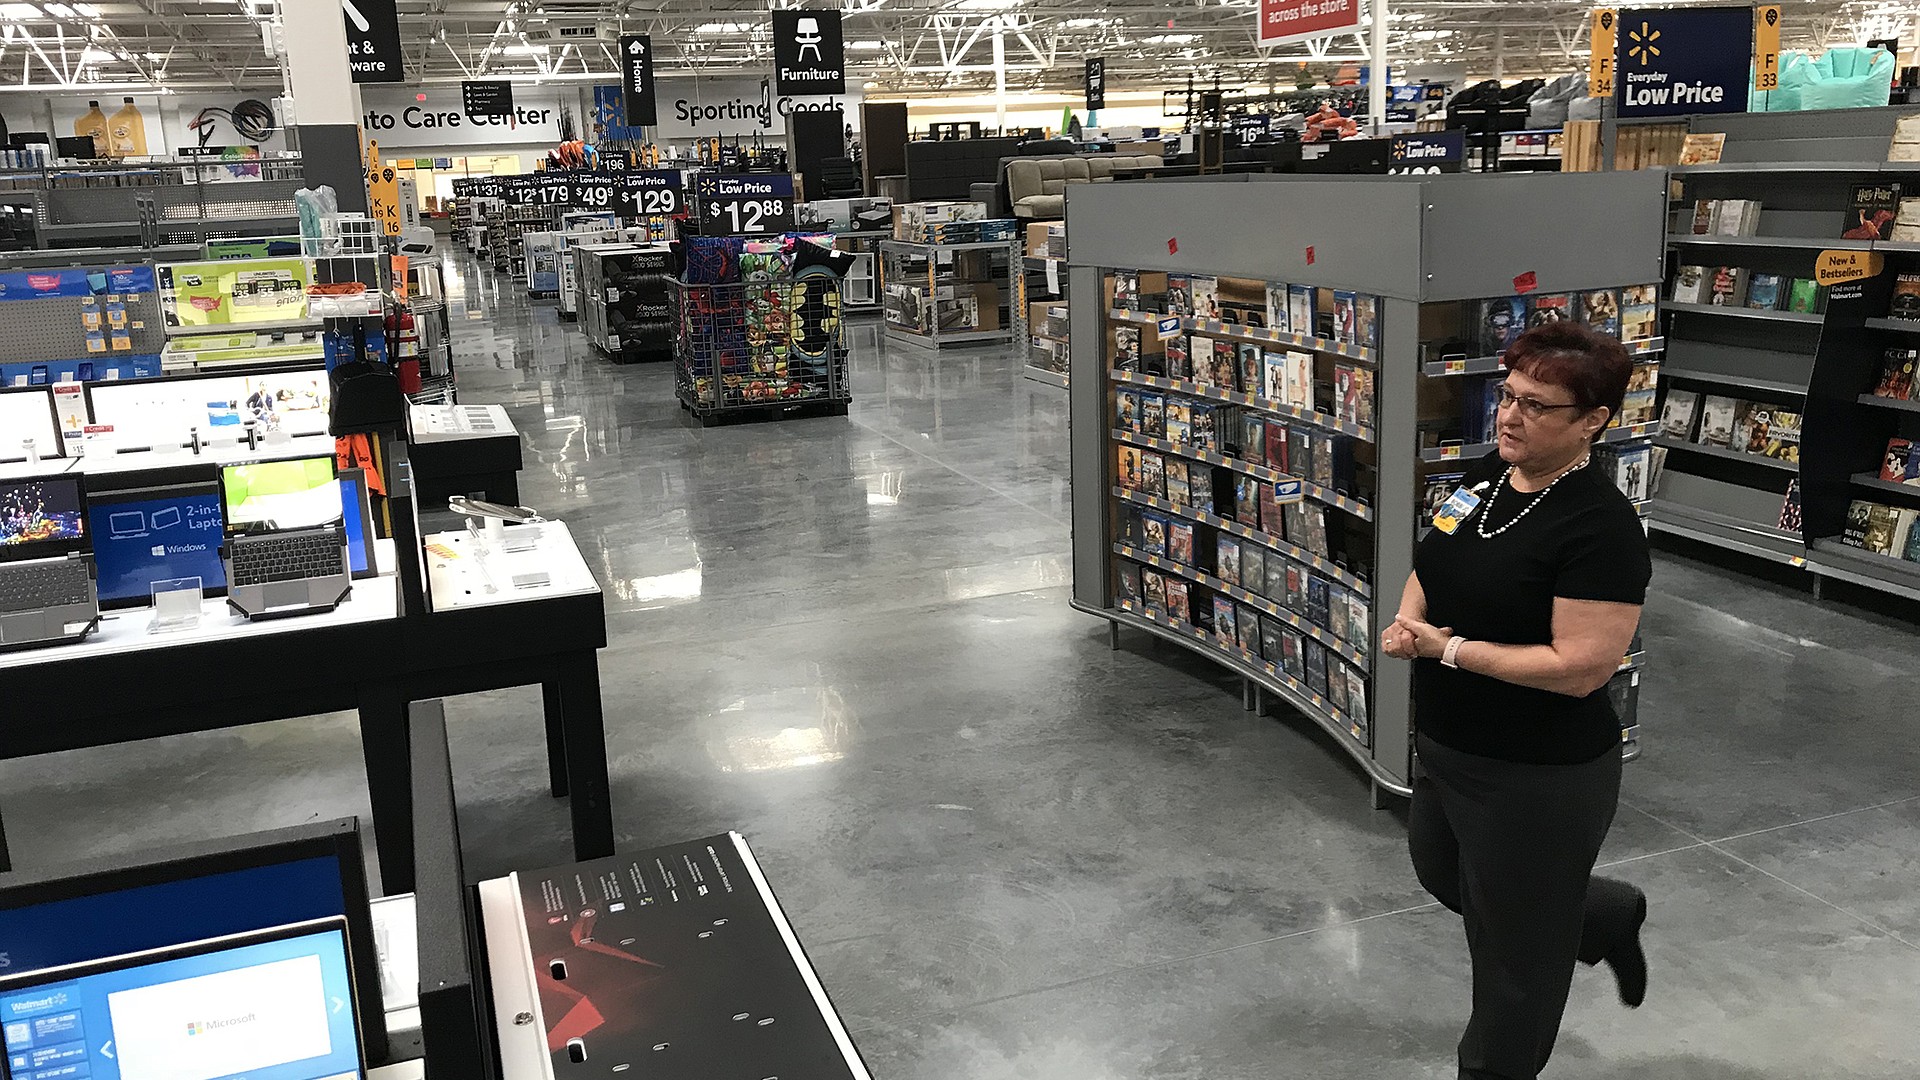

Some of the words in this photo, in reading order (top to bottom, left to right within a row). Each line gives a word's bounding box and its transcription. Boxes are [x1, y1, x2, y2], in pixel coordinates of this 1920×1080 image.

[1268, 7, 1300, 23] across
[1301, 1, 1318, 18] the
[1320, 0, 1350, 15] store.
[363, 40, 375, 54] &
[350, 61, 386, 72] ware
[1600, 58, 1609, 75] F
[1766, 54, 1775, 69] F
[632, 59, 643, 94] Home
[781, 67, 840, 82] Furniture
[1627, 71, 1669, 84] Everyday
[1762, 73, 1777, 87] 33
[1597, 79, 1611, 94] 34
[1625, 84, 1670, 107] Low
[1672, 80, 1724, 104] Price
[403, 106, 461, 129] Care
[1406, 146, 1424, 158] Low
[1424, 143, 1447, 157] Price
[594, 176, 612, 184] Price
[627, 178, 645, 187] Low
[645, 177, 666, 186] Price
[719, 184, 743, 195] Low
[744, 182, 772, 194] Price
[374, 198, 383, 208] K
[386, 204, 397, 218] K
[387, 221, 400, 233] 16
[1828, 256, 1848, 267] New
[1849, 254, 1857, 265] &
[1820, 267, 1864, 279] Bestsellers
[186, 503, 221, 517] 2-in-1
[166, 543, 207, 554] Windows
[11, 996, 54, 1012] Walmart
[206, 1012, 256, 1030] Microsoft
